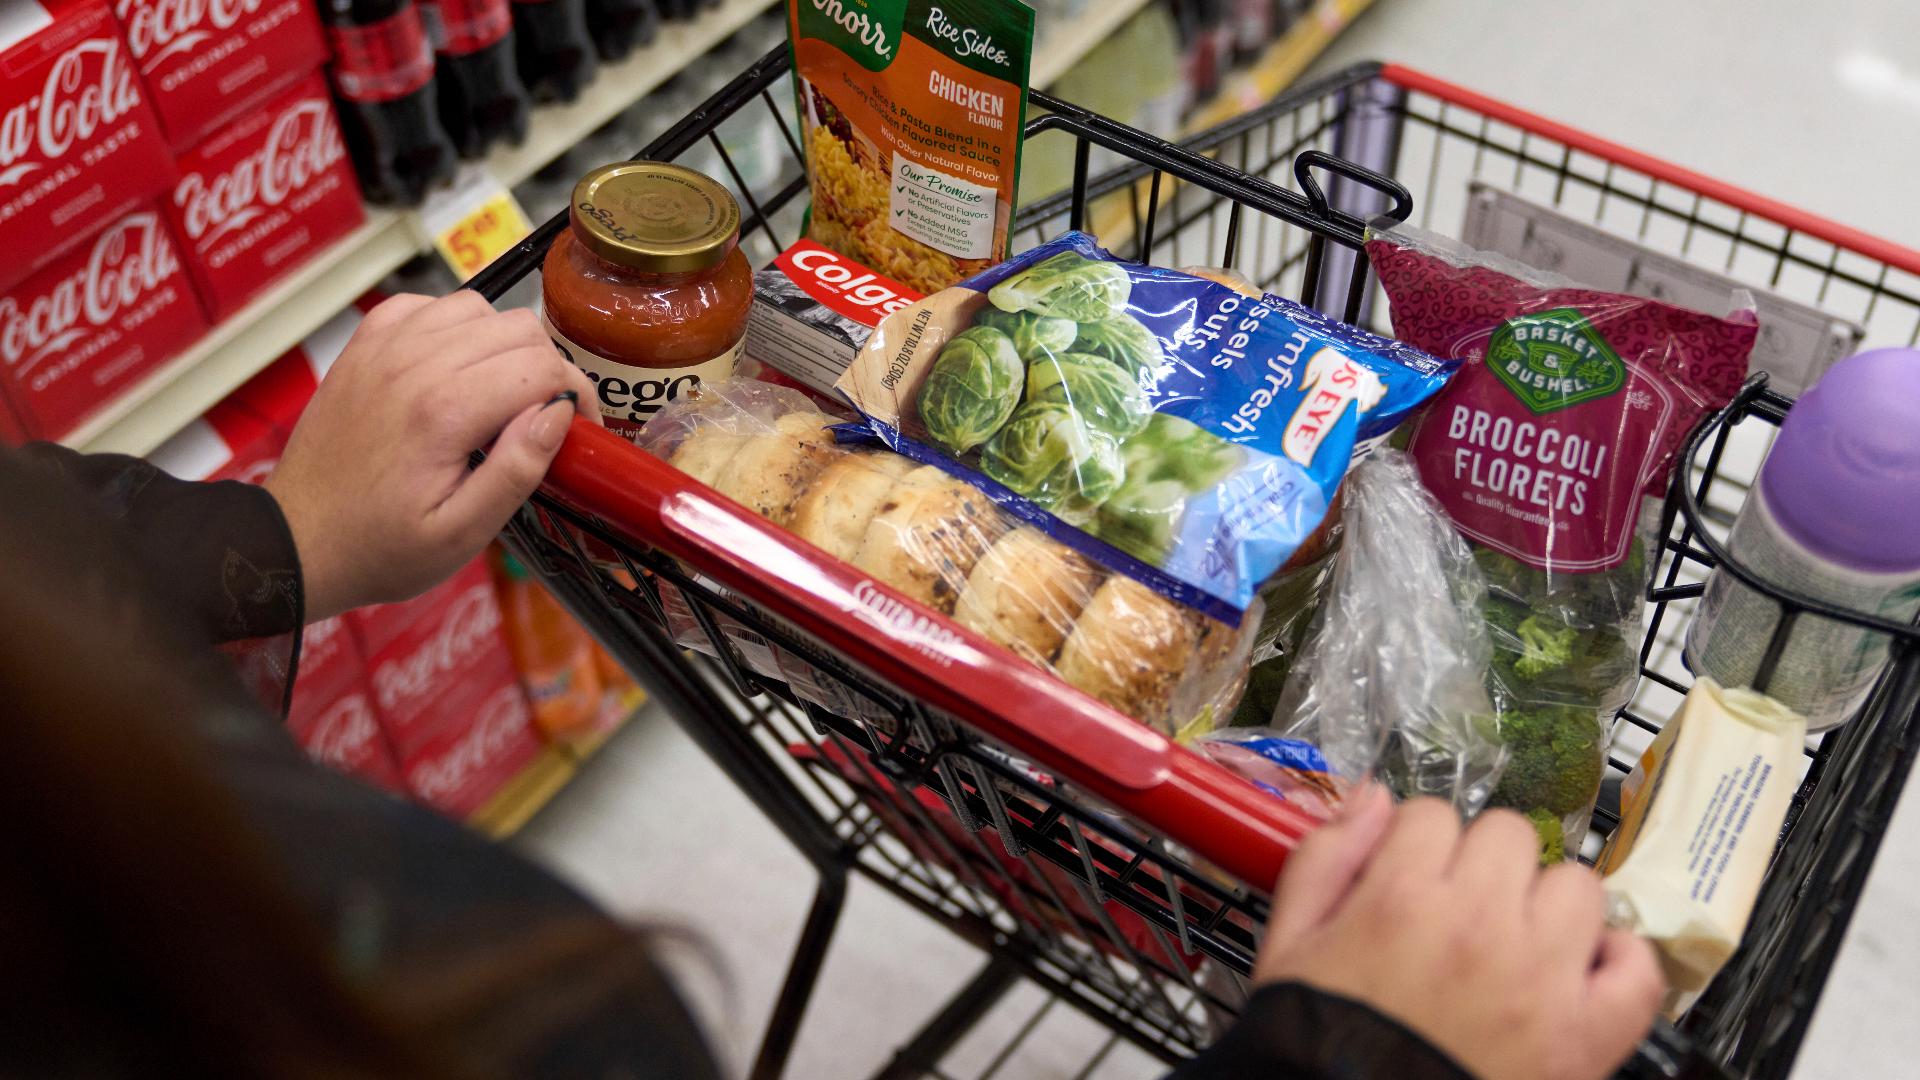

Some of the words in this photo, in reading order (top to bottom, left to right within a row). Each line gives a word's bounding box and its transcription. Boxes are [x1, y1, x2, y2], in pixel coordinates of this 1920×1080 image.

[926, 7, 959, 42] Rice
[955, 28, 1008, 64] Sides
[929, 69, 1004, 117] CHICKEN
[869, 98, 900, 131] Chicken
[902, 124, 956, 153] Flavored
[959, 145, 1000, 167] Sauce
[891, 102, 898, 114] &
[899, 107, 931, 133] Pasta
[934, 126, 974, 145] Blend
[977, 138, 989, 150] in
[992, 146, 1001, 155] a
[968, 111, 1003, 131] FLAVOR
[881, 124, 896, 145] With
[897, 137, 922, 159] Other
[924, 152, 964, 172] Natural
[966, 165, 1000, 182] Flavor
[900, 164, 923, 181] Our
[926, 175, 983, 203] Promise
[908, 188, 920, 198] No
[920, 192, 955, 212] Artificial
[956, 207, 989, 219] Flavors
[917, 201, 971, 226] Preservatives
[579, 202, 639, 242] Prego
[907, 209, 918, 219] No
[919, 212, 946, 231] Added
[947, 226, 969, 238] MSG
[791, 249, 915, 317] Colga
[908, 322, 925, 340] WT
[914, 307, 932, 326] NET
[900, 336, 918, 356] 10.8
[1211, 301, 1270, 370] ssels
[1514, 327, 1598, 359] BASKET
[879, 360, 906, 392] (306g)
[895, 352, 911, 366] OZ
[1506, 360, 1586, 393] BUSHEL
[1544, 354, 1560, 370] &
[1222, 328, 1311, 433] mfresh
[1294, 390, 1342, 441] EYE
[1448, 404, 1607, 480] BROCCOLI
[1454, 447, 1587, 516] FLORETS
[1475, 494, 1505, 514] Quality
